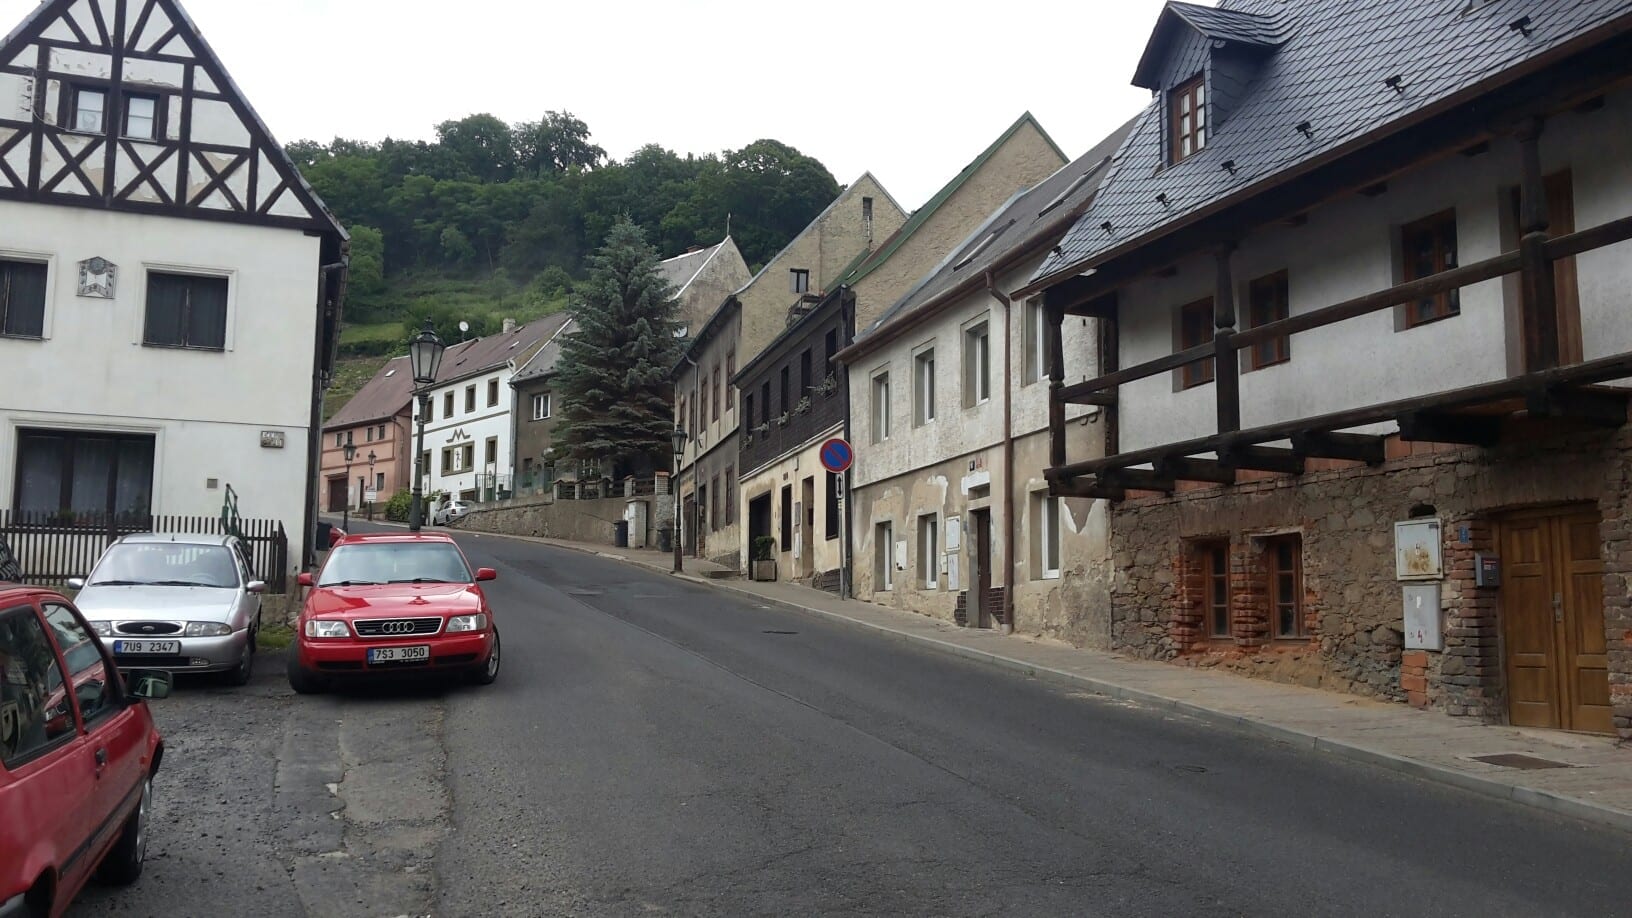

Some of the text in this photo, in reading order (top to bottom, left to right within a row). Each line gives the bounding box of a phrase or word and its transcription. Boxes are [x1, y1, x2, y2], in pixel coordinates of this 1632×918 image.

[123, 642, 174, 652] 7U9 2347
[376, 647, 425, 659] 7S3 3050
